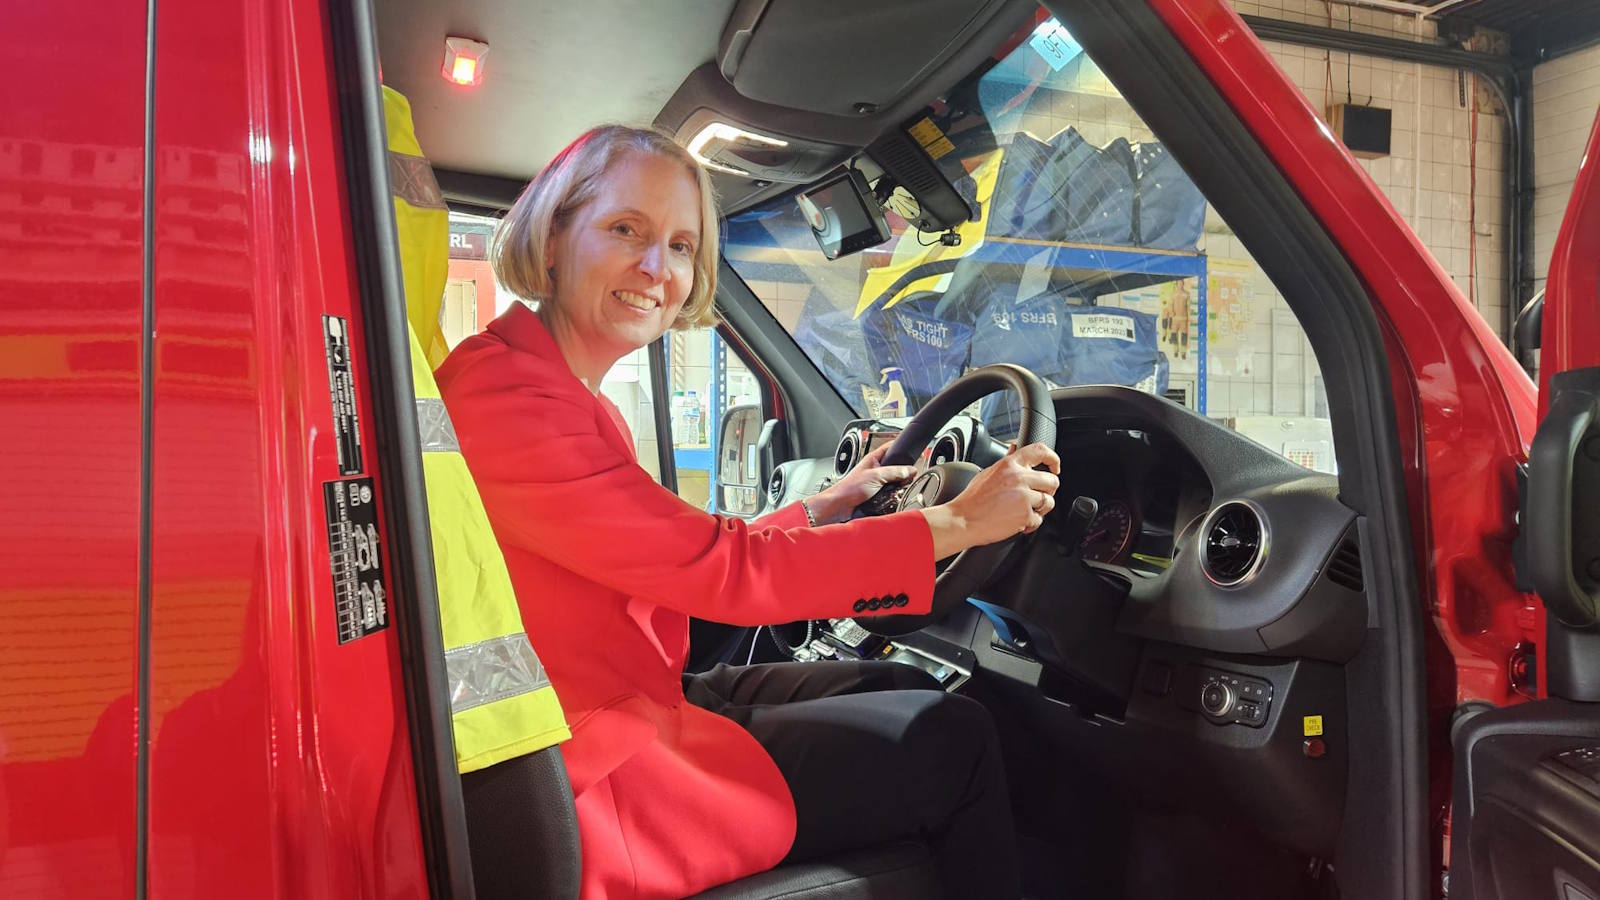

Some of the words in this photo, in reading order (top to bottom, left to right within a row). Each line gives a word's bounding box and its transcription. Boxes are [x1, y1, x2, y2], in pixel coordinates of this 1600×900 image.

[1020, 312, 1056, 325] BFRS
[916, 320, 948, 338] TIGHT
[1080, 326, 1108, 335] MARCH
